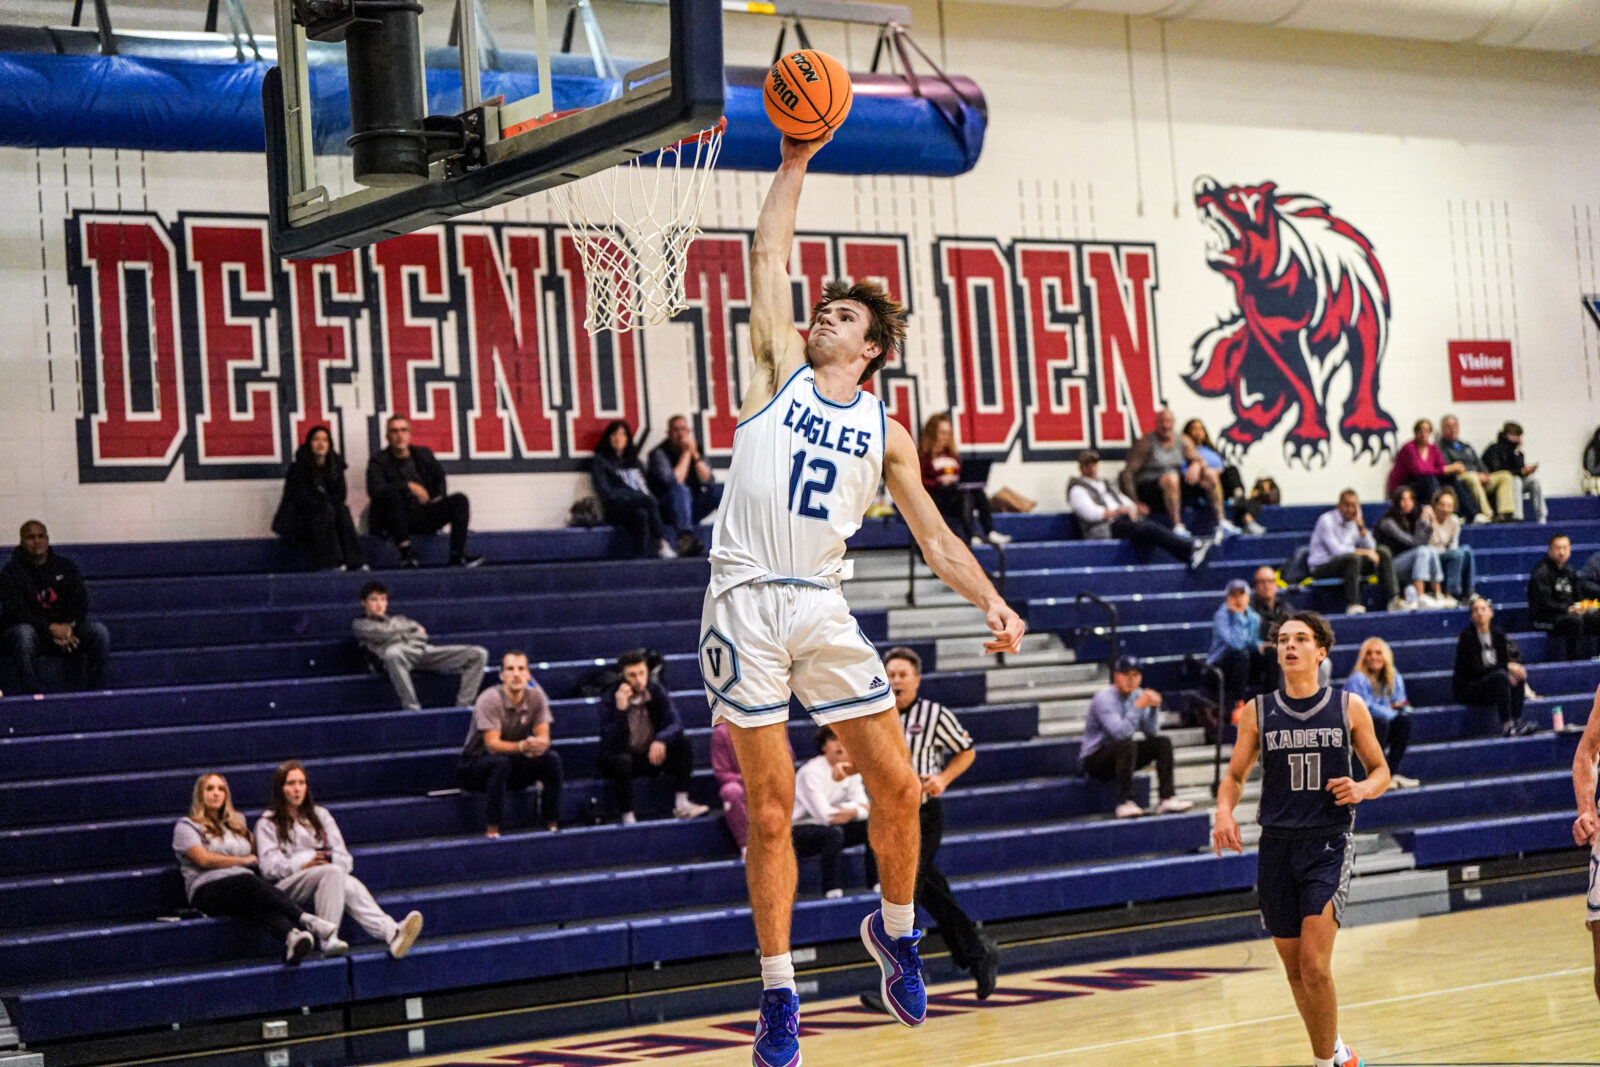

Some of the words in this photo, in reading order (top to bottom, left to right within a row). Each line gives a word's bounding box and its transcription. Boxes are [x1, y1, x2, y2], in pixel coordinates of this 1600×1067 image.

[791, 53, 819, 83] NCAA
[65, 209, 650, 484] DEFEND
[668, 229, 920, 468] TE
[931, 235, 1167, 463] DEN
[782, 398, 872, 459] EAGLES
[788, 448, 838, 521] 12
[1265, 728, 1343, 751] KADETS
[1288, 752, 1321, 791] 11
